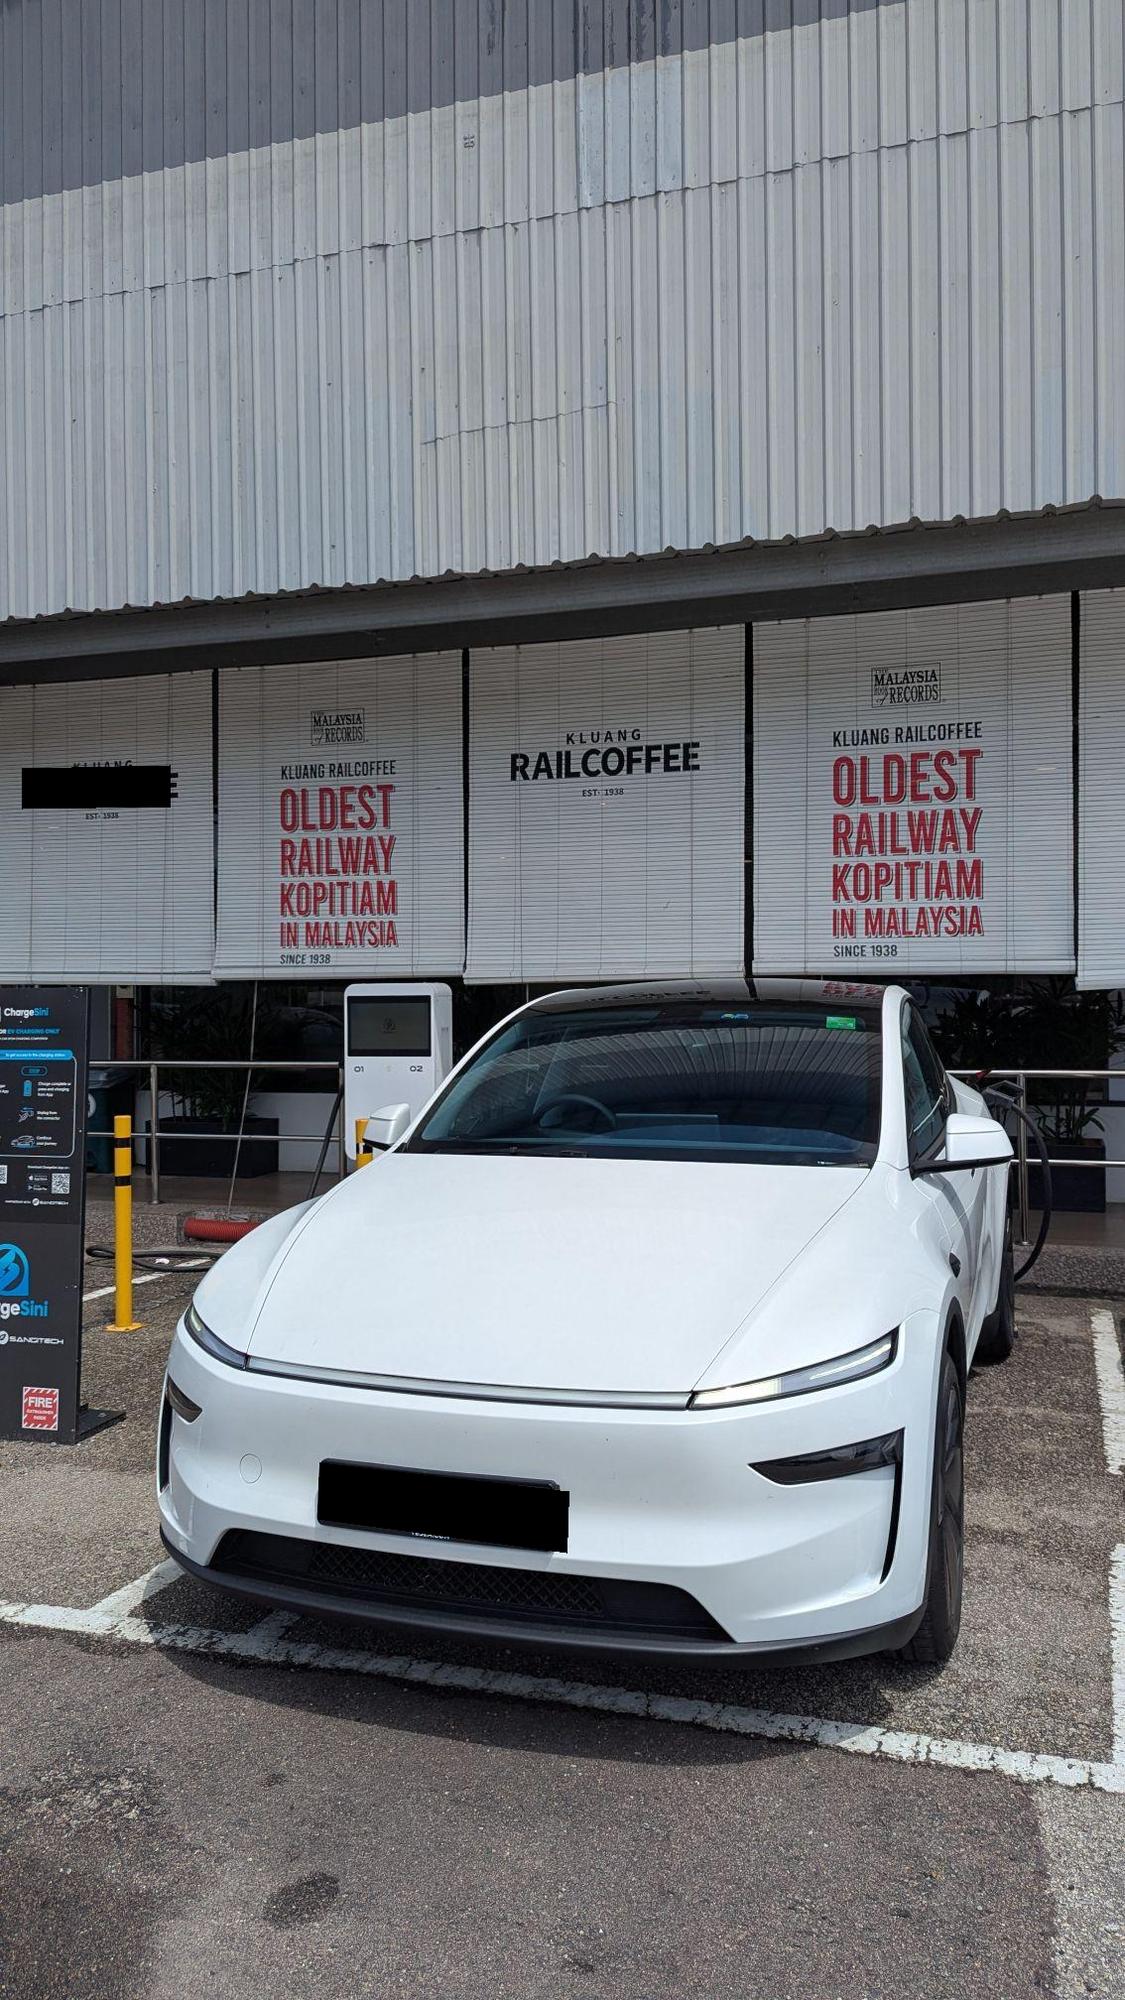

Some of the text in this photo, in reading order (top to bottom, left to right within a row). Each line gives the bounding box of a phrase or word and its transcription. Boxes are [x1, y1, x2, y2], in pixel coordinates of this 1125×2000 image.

[874, 669, 938, 686] MALAYSIA
[889, 684, 939, 704] RECORDS
[313, 713, 363, 727] MALAYSIA
[325, 726, 363, 743] RECORDS
[566, 729, 641, 745] KLUANG
[833, 722, 982, 747] KLUANG RAILCOFFEE
[281, 760, 397, 780] KLUANG RAILCOFFEE
[510, 741, 700, 781] RAILCOFFEE
[833, 748, 983, 806] OLDEST
[605, 787, 624, 796] 1938
[280, 784, 395, 833] OLDEST
[833, 807, 983, 857] RAILWAY
[280, 834, 396, 877] RAILWAY
[832, 859, 984, 904] KOPITIAM
[280, 880, 398, 917] KOPITIAM
[832, 905, 984, 939] IN MALAYSIA
[280, 919, 398, 948] IN MALAYSIA
[280, 953, 331, 965] SINCE 1938
[833, 944, 898, 957] SINCE 1938
[4, 1007, 49, 1019] ChargeSini
[0, 1301, 49, 1320] geSini
[28, 1396, 53, 1408] FIRE
